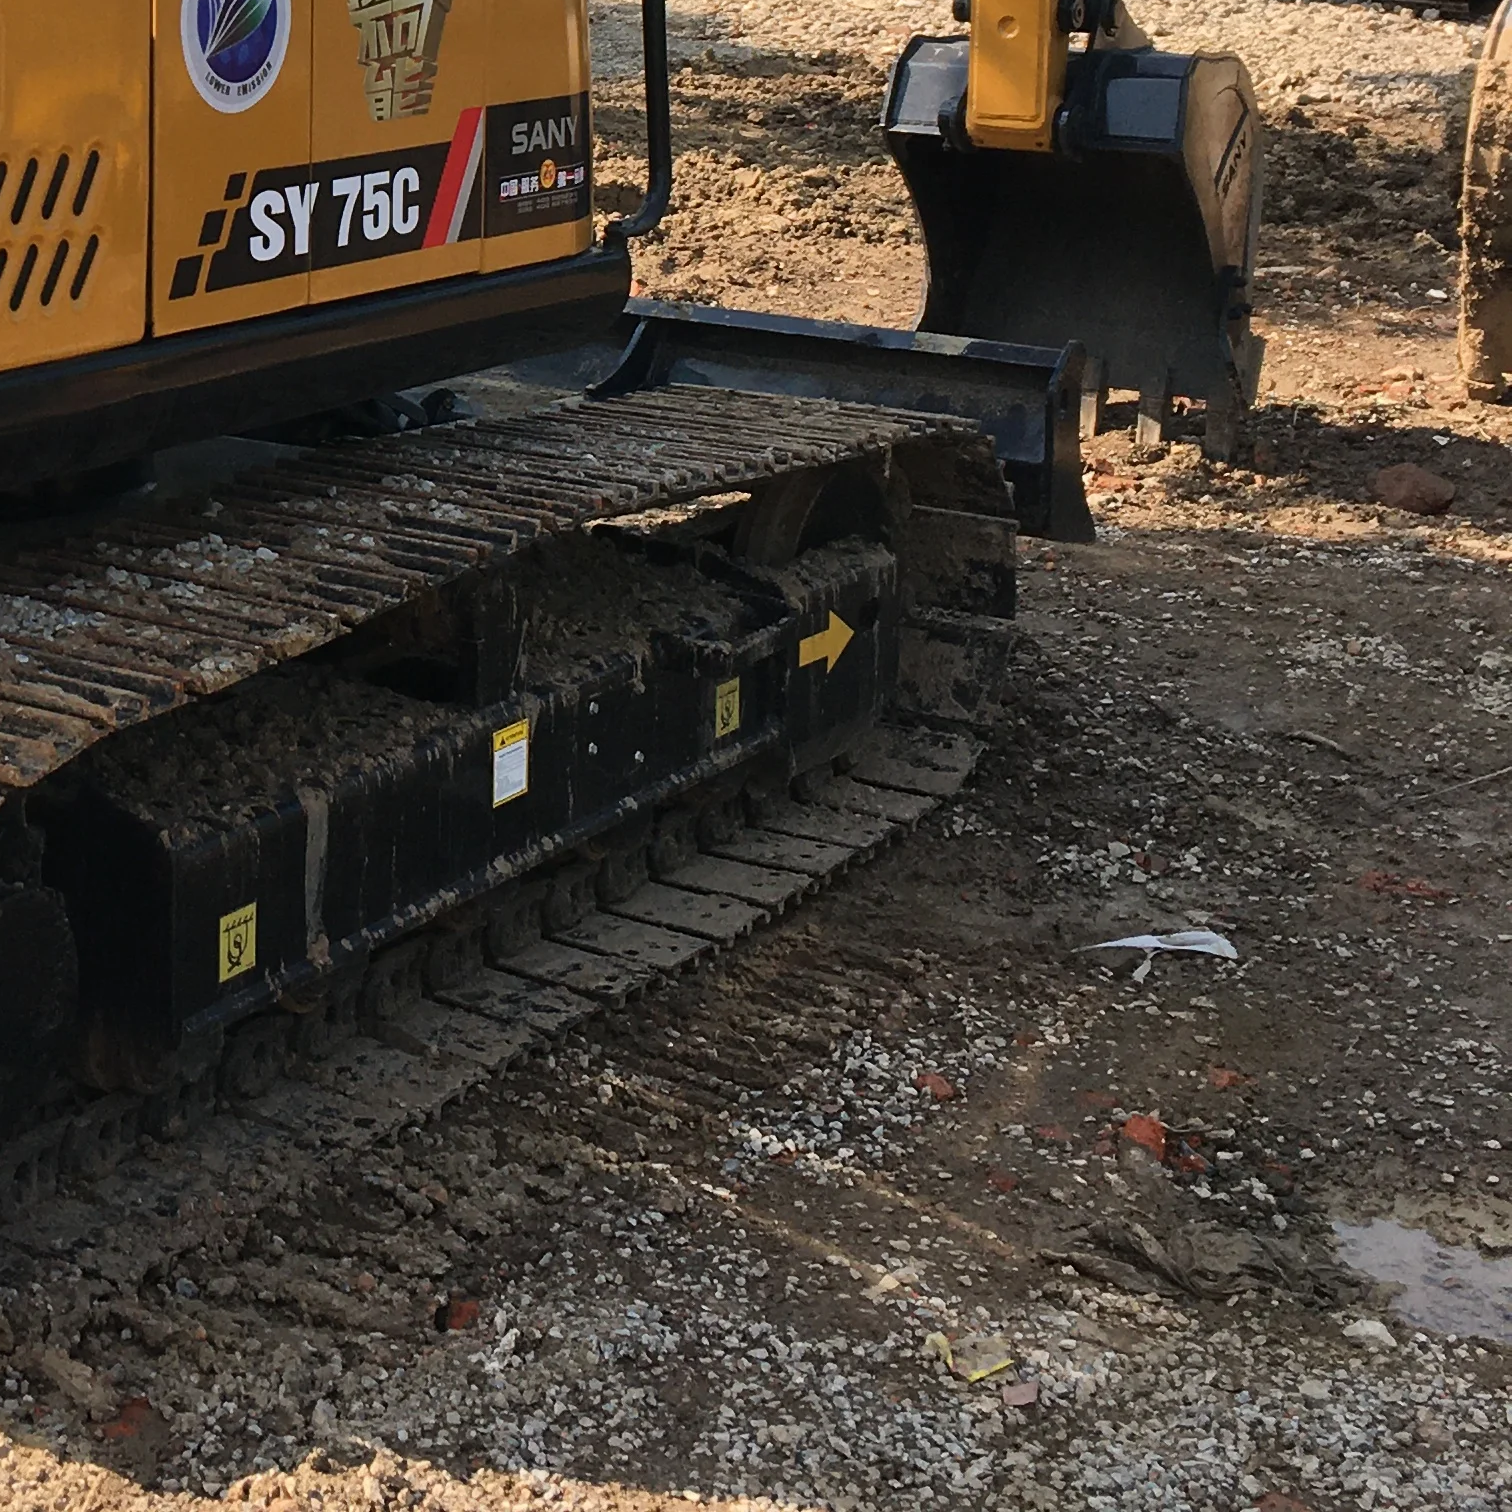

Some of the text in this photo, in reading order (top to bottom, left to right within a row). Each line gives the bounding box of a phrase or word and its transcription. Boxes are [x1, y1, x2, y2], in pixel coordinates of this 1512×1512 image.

[205, 61, 273, 96] LOWER EMISSION
[511, 115, 578, 155] SANY
[1222, 131, 1246, 199] SANY
[249, 166, 420, 262] SY 75C
